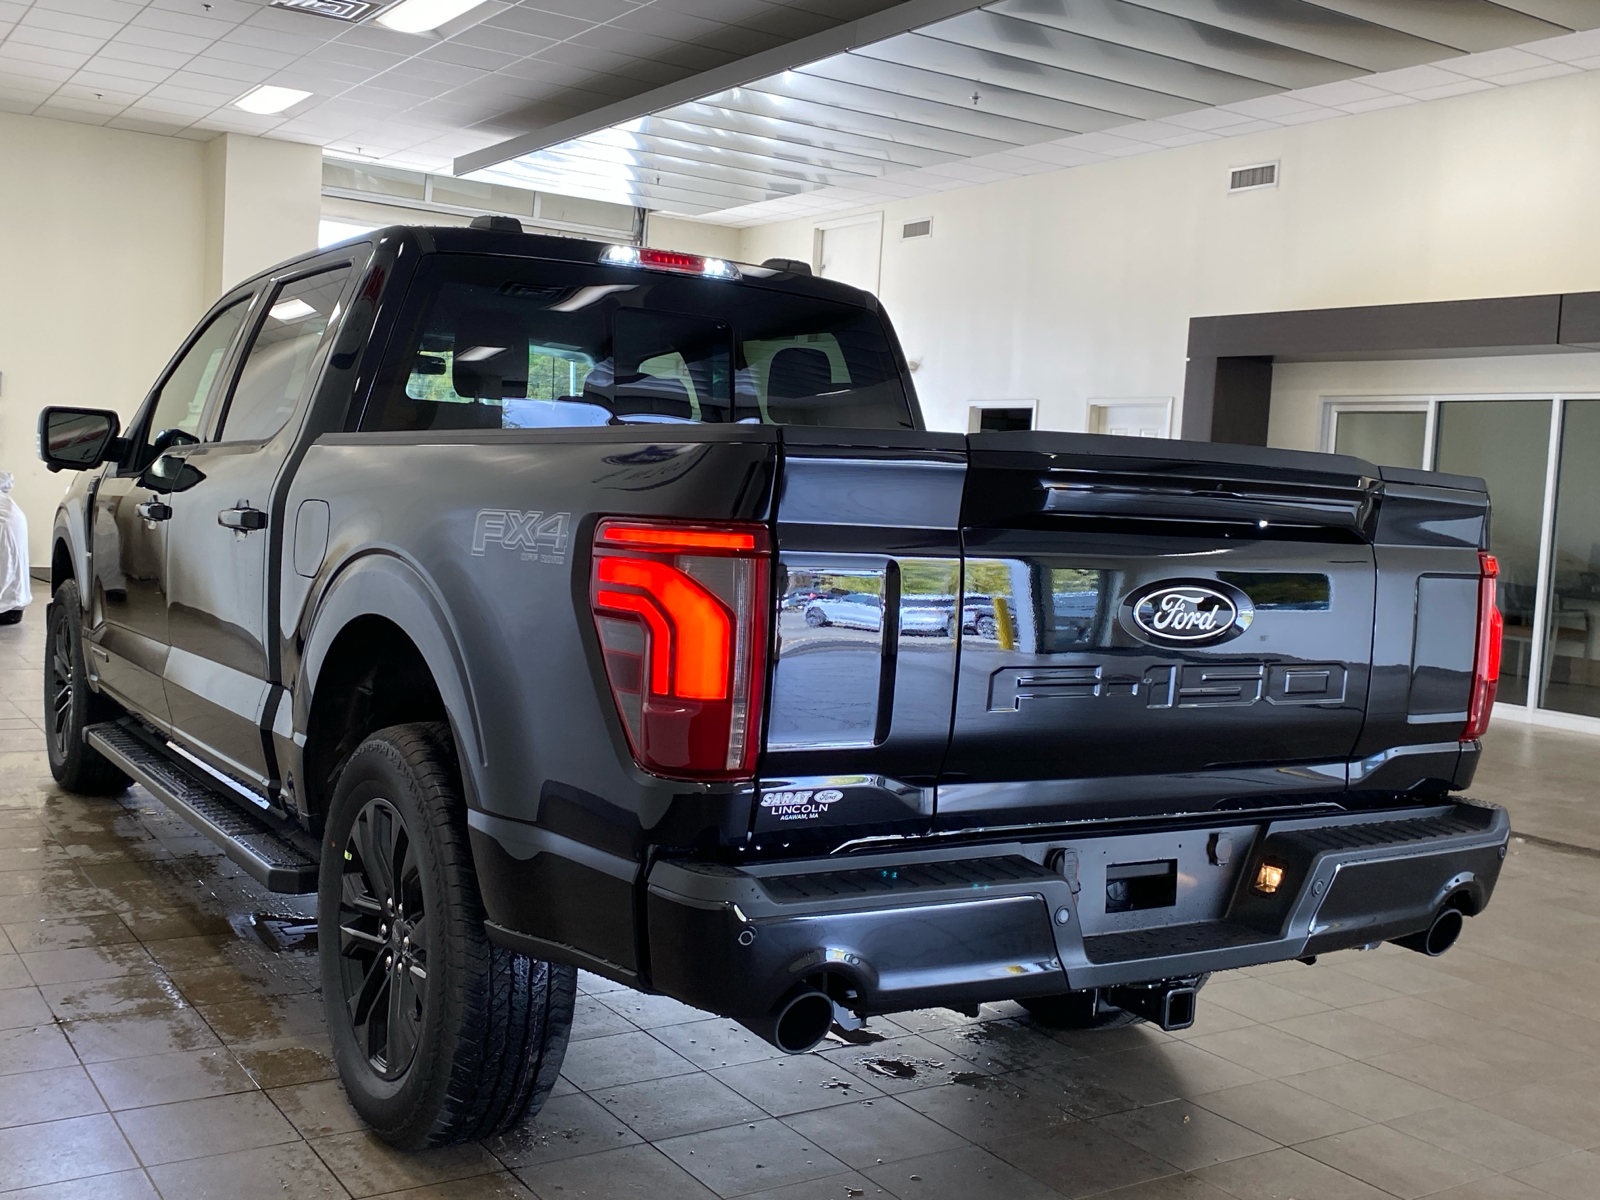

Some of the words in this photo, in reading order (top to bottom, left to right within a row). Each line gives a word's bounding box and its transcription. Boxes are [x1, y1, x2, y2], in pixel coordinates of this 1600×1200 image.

[471, 508, 571, 557] FX4
[1153, 593, 1220, 630] Ford
[986, 664, 1348, 712] F-150
[760, 791, 813, 806] SARAT
[771, 804, 828, 815] LINCOLN
